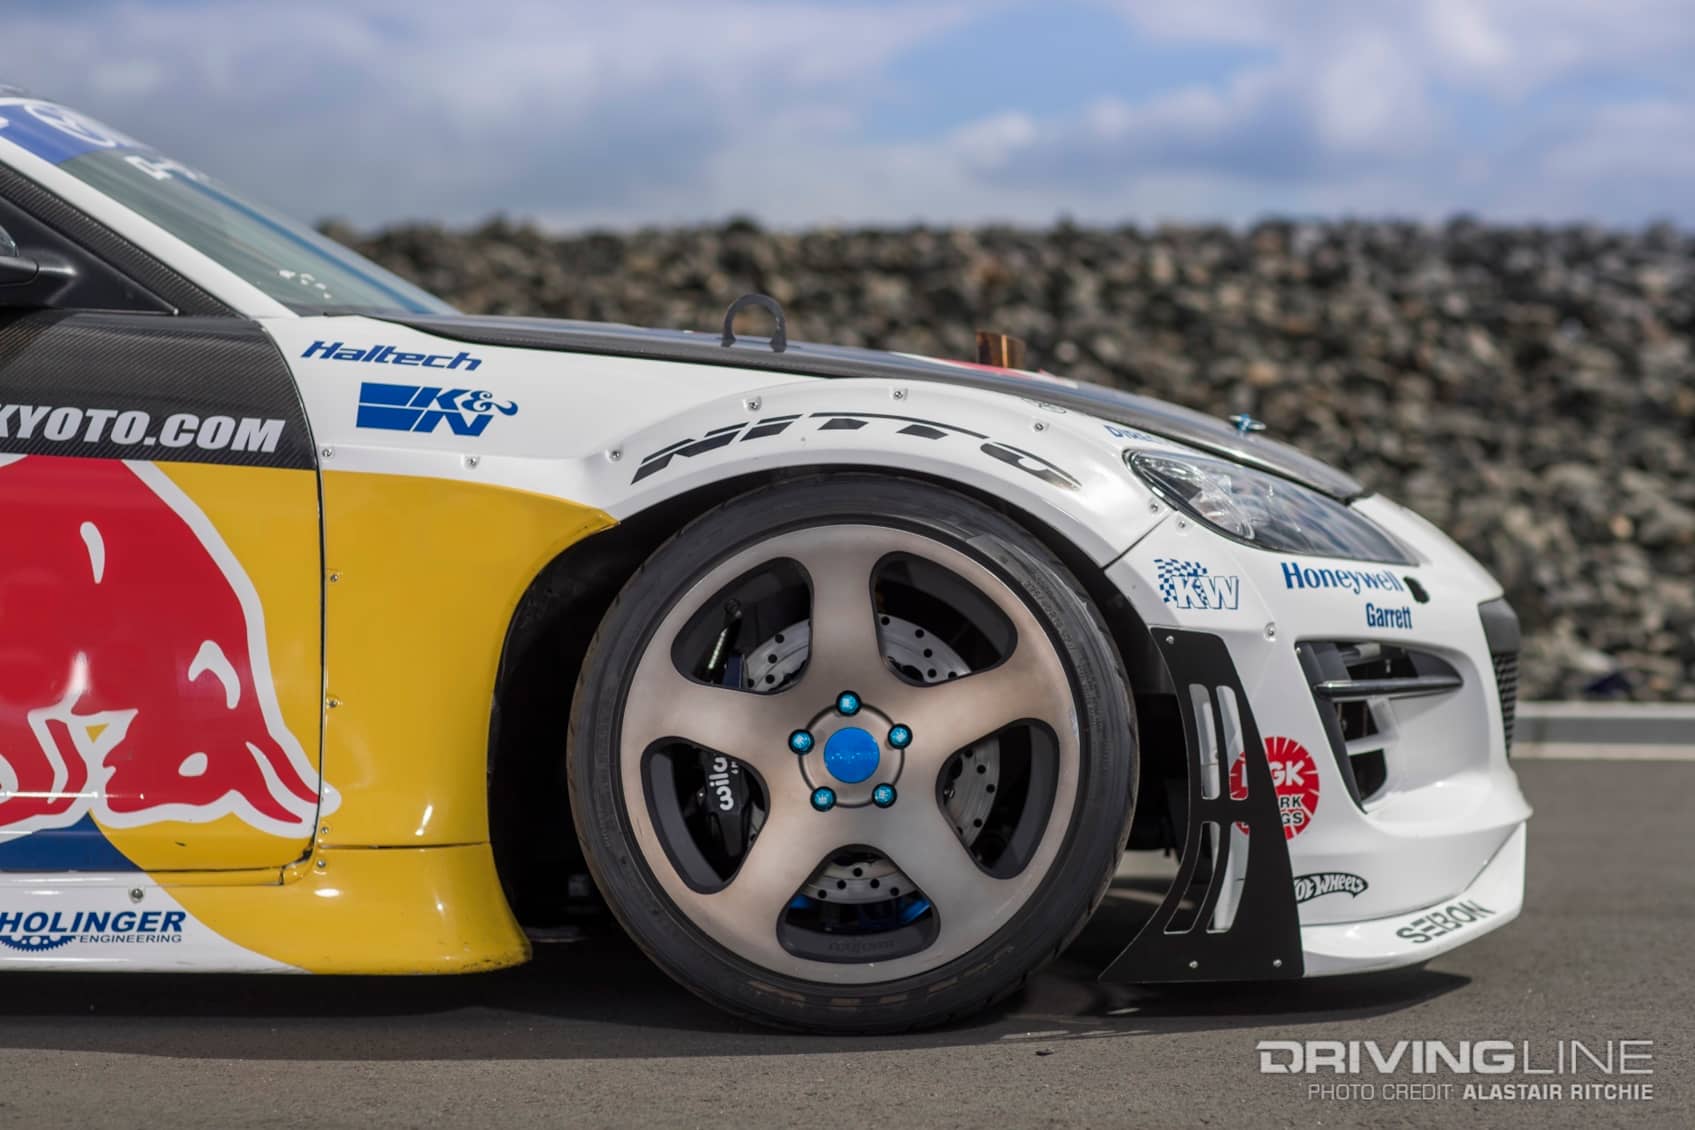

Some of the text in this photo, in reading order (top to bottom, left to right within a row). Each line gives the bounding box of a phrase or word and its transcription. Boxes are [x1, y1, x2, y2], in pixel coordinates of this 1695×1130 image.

[302, 340, 482, 372] Haltech
[1171, 575, 1240, 610] KW
[1281, 562, 1405, 594] Honeywell
[1365, 602, 1413, 630] Garrett
[0, 911, 187, 934] HOLINGER
[79, 934, 183, 944] ENGINEERING
